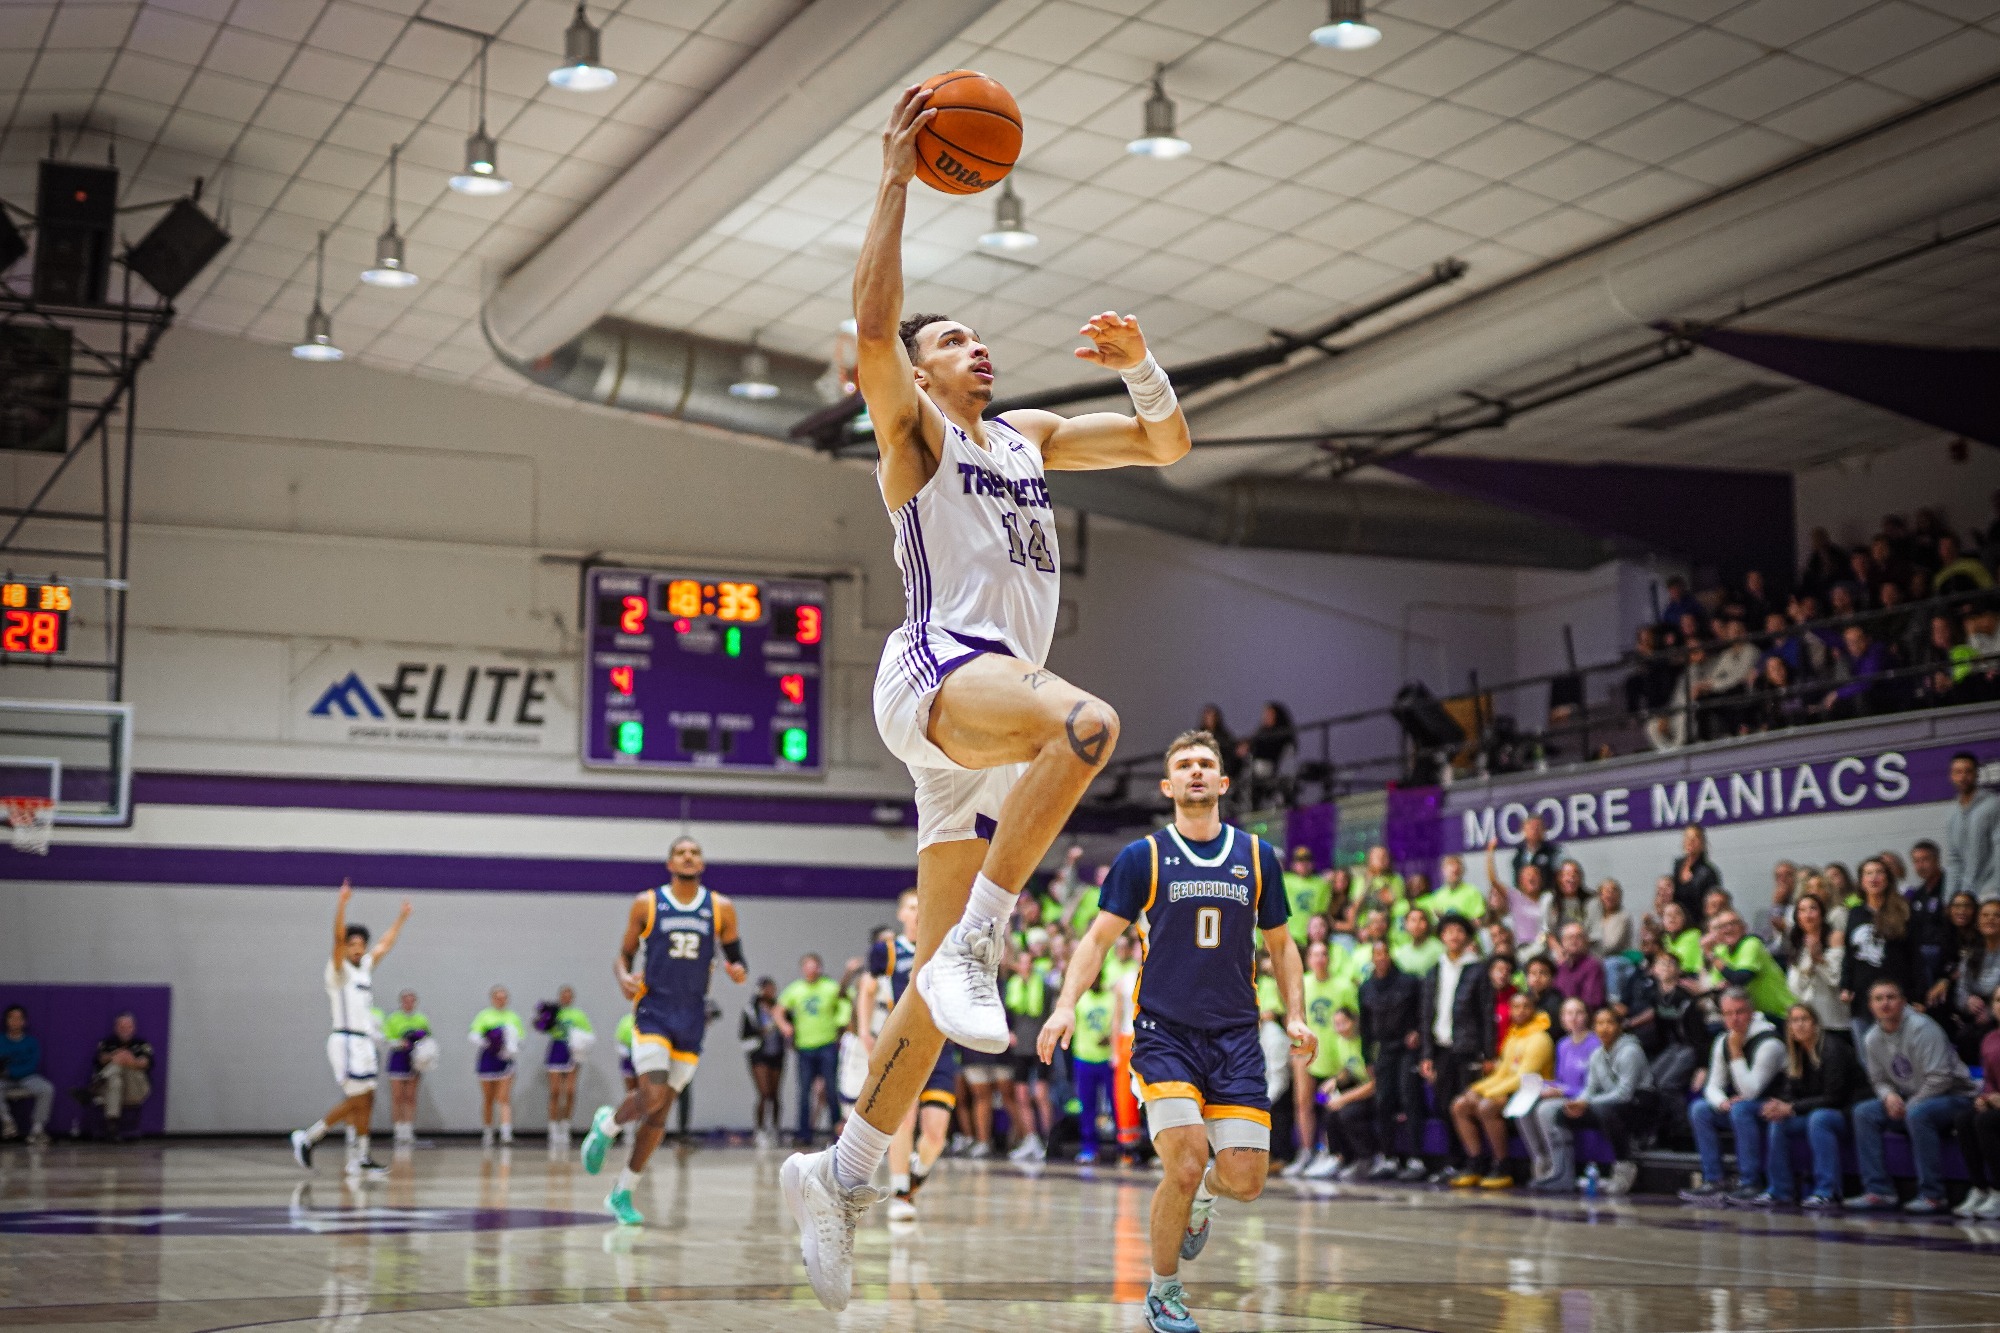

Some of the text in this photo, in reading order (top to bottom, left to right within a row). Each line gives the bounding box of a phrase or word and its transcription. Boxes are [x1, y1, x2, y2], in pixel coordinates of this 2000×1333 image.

[1002, 512, 1055, 573] 14
[39, 585, 71, 611] 35
[620, 595, 648, 634] 2
[3, 610, 59, 654] 28
[795, 605, 821, 644] 3
[377, 661, 547, 726] ELITE
[1463, 751, 1910, 850] MOORE MANIACS
[1169, 880, 1250, 906] CEDARVILLE
[668, 930, 701, 960] 32
[1196, 906, 1222, 949] 0
